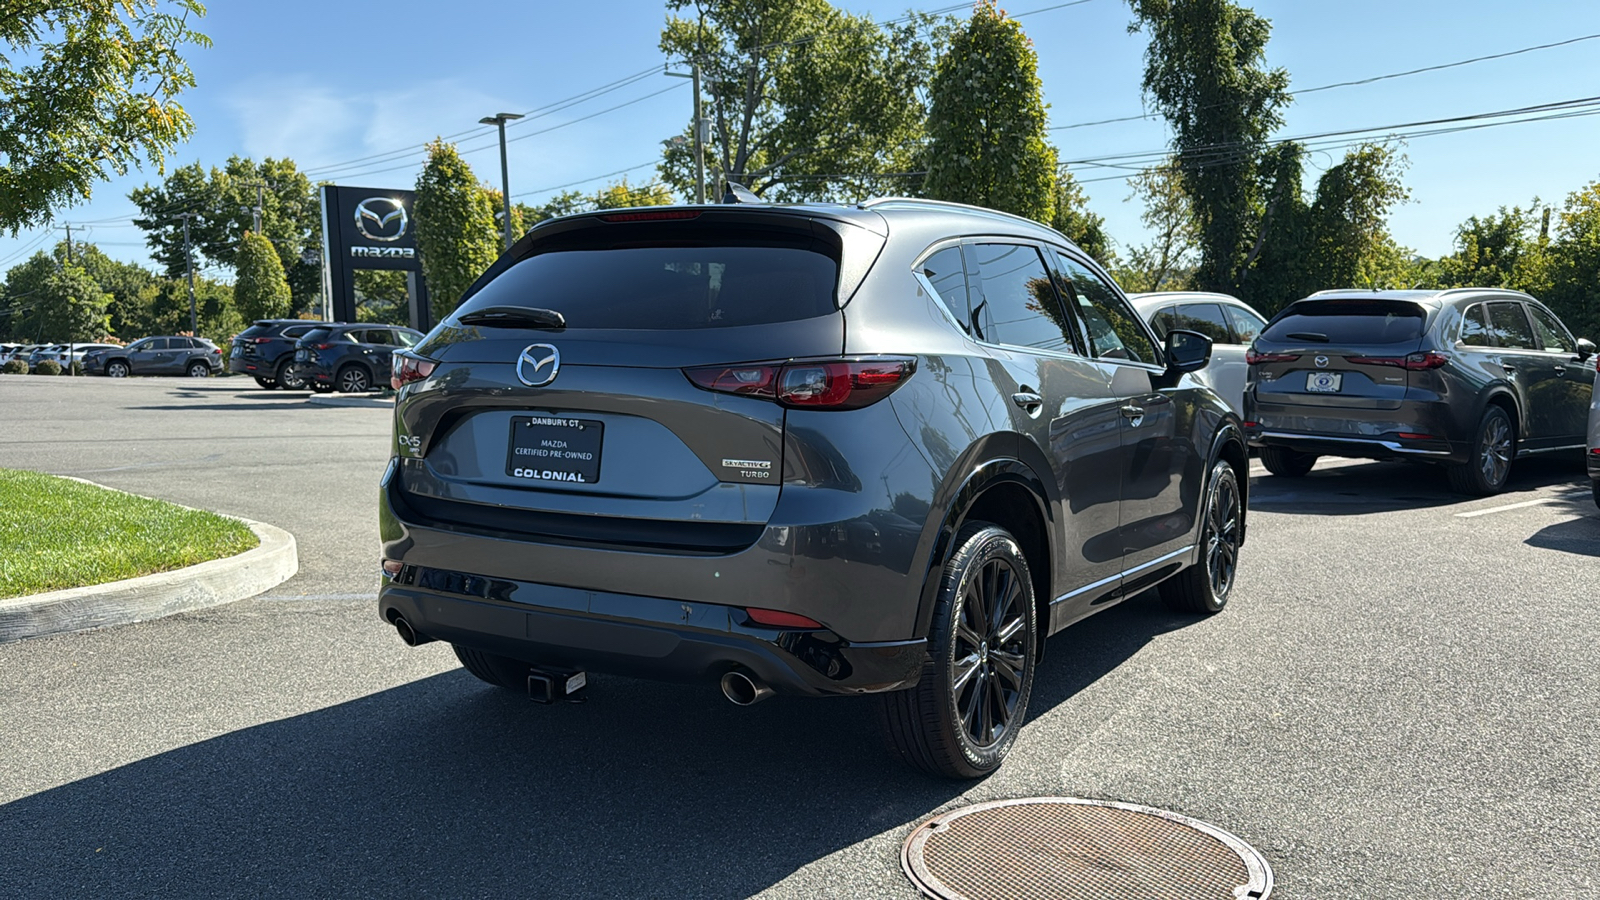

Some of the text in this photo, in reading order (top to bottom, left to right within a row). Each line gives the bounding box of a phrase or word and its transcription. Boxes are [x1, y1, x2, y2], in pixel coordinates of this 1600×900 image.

[532, 417, 580, 428] DANBURY CT
[541, 439, 568, 449] MAZDA
[515, 447, 593, 461] CERTIFIED PRE-OWNED
[514, 468, 585, 482] COLONIAL
[740, 470, 769, 478] TURBO
